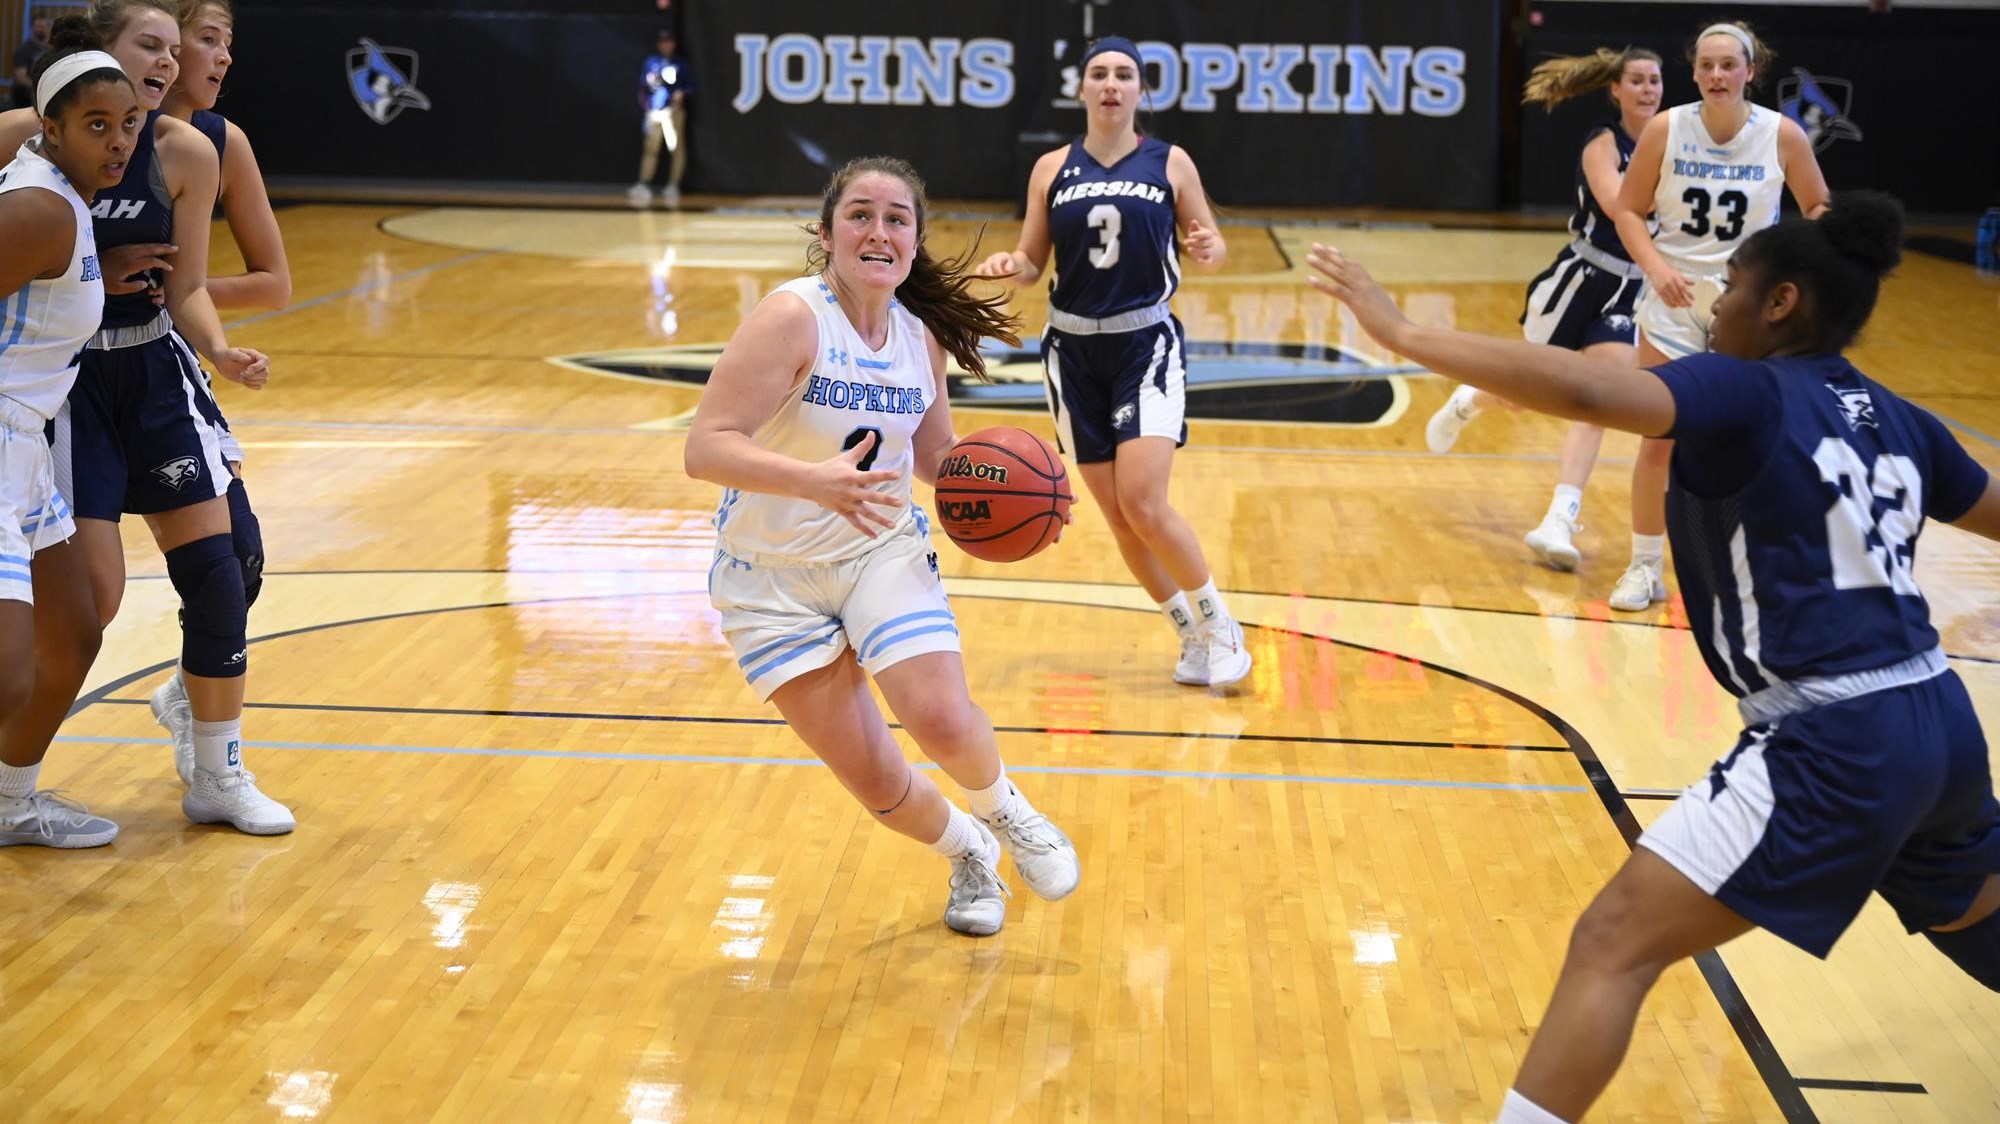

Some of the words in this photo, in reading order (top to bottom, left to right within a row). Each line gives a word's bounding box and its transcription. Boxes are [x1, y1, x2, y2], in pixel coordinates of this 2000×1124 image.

[733, 34, 1014, 113] JOHNS
[1055, 40, 1466, 116] OPKINS
[1673, 158, 1765, 181] HOPKINS
[90, 198, 148, 220] AH
[1051, 180, 1167, 209] MESSIAH
[1680, 186, 1748, 242] 33
[1087, 203, 1122, 270] 3
[802, 374, 926, 415] HOPKINS
[937, 454, 1008, 485] Wilson
[1812, 436, 1923, 597] 22
